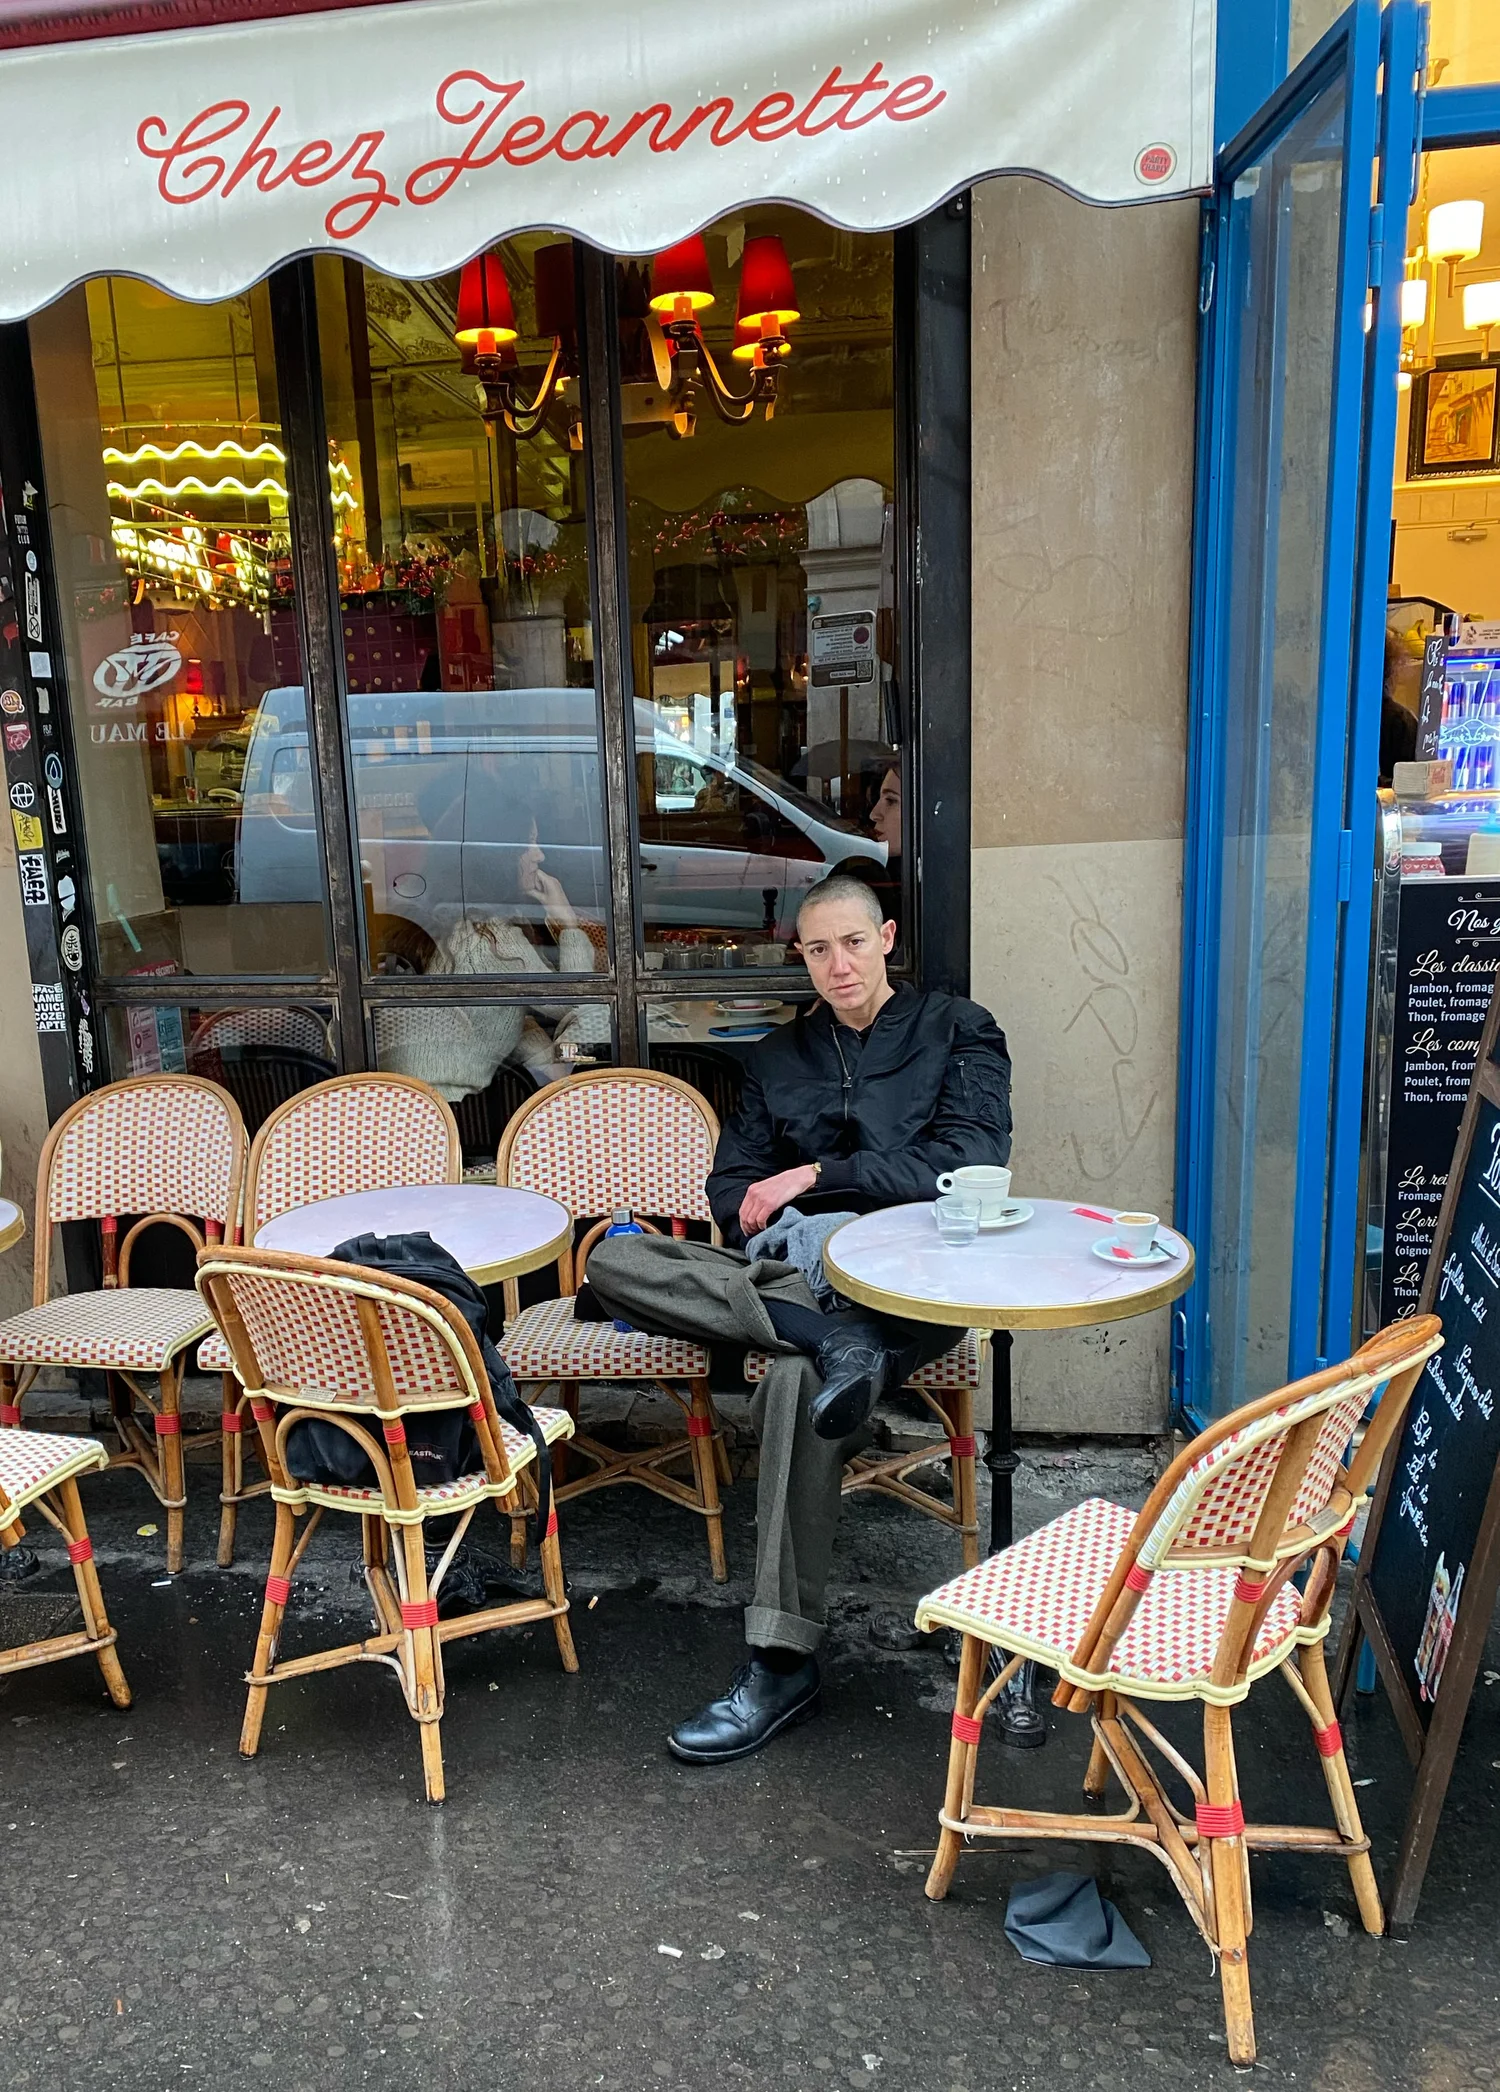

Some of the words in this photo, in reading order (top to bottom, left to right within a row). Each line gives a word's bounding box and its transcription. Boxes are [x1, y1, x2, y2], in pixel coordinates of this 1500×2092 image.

[137, 98, 399, 239] Chez
[406, 62, 947, 205] Jeannette
[1448, 909, 1490, 932] Nos
[1409, 949, 1447, 981] Les
[1408, 983, 1453, 995] Jambon,
[1408, 997, 1447, 1009] Poulet,
[1408, 1012, 1437, 1023] Thon,
[1440, 1011, 1485, 1023] fromage
[1405, 1027, 1442, 1059] Les
[1404, 1060, 1449, 1073] Jambon,
[1404, 1076, 1442, 1087] Poulet,
[1404, 1092, 1433, 1103] Thon,
[1398, 1165, 1427, 1191] La
[1396, 1232, 1433, 1244] Poulet,
[1393, 1262, 1421, 1287] La
